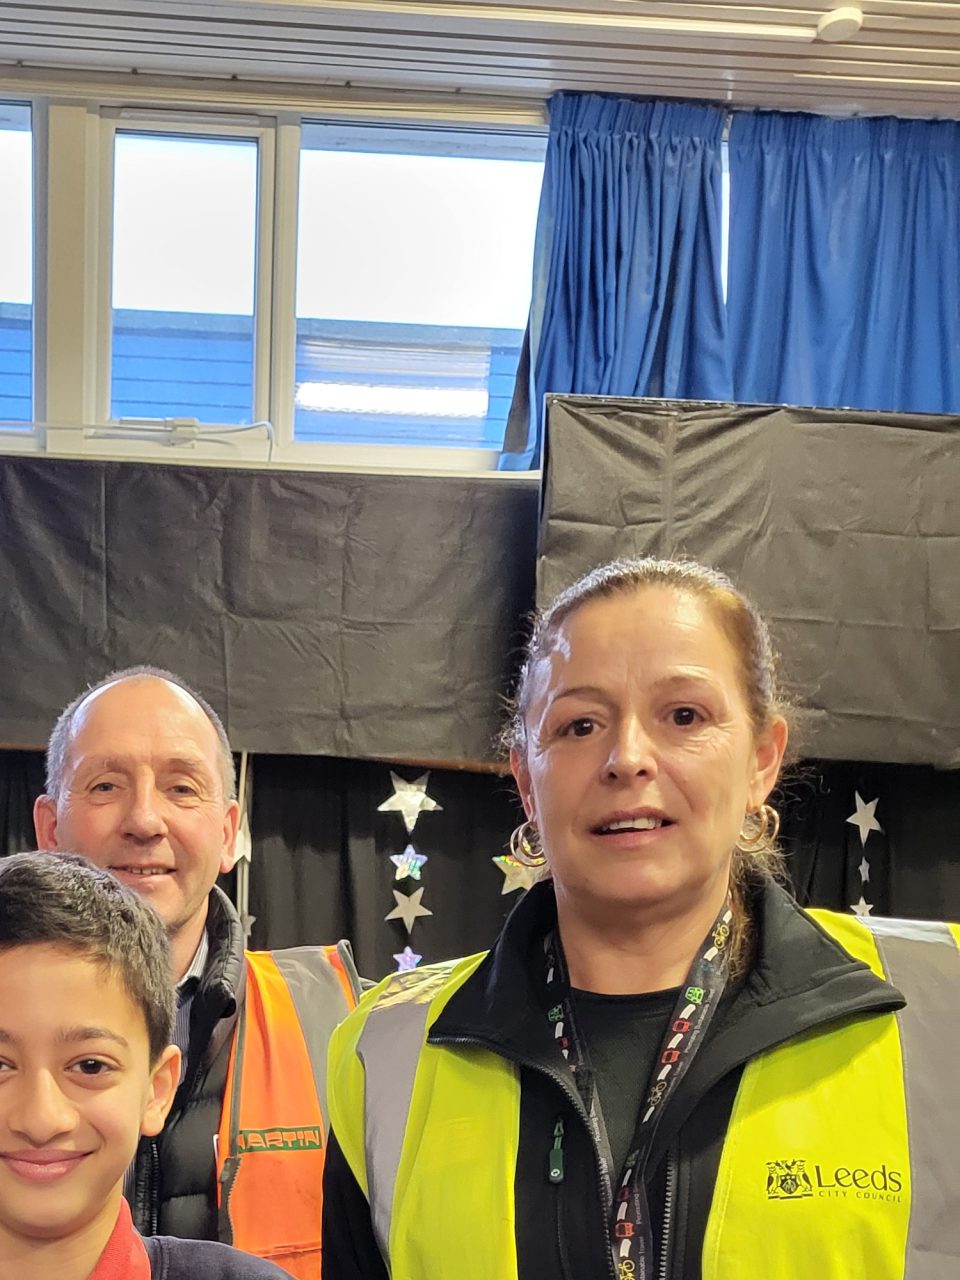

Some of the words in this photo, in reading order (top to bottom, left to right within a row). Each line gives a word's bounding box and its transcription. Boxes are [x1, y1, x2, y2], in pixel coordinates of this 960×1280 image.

[815, 1165, 903, 1193] Leeds
[819, 1190, 848, 1198] CITY
[855, 1192, 903, 1203] COUNCIL
